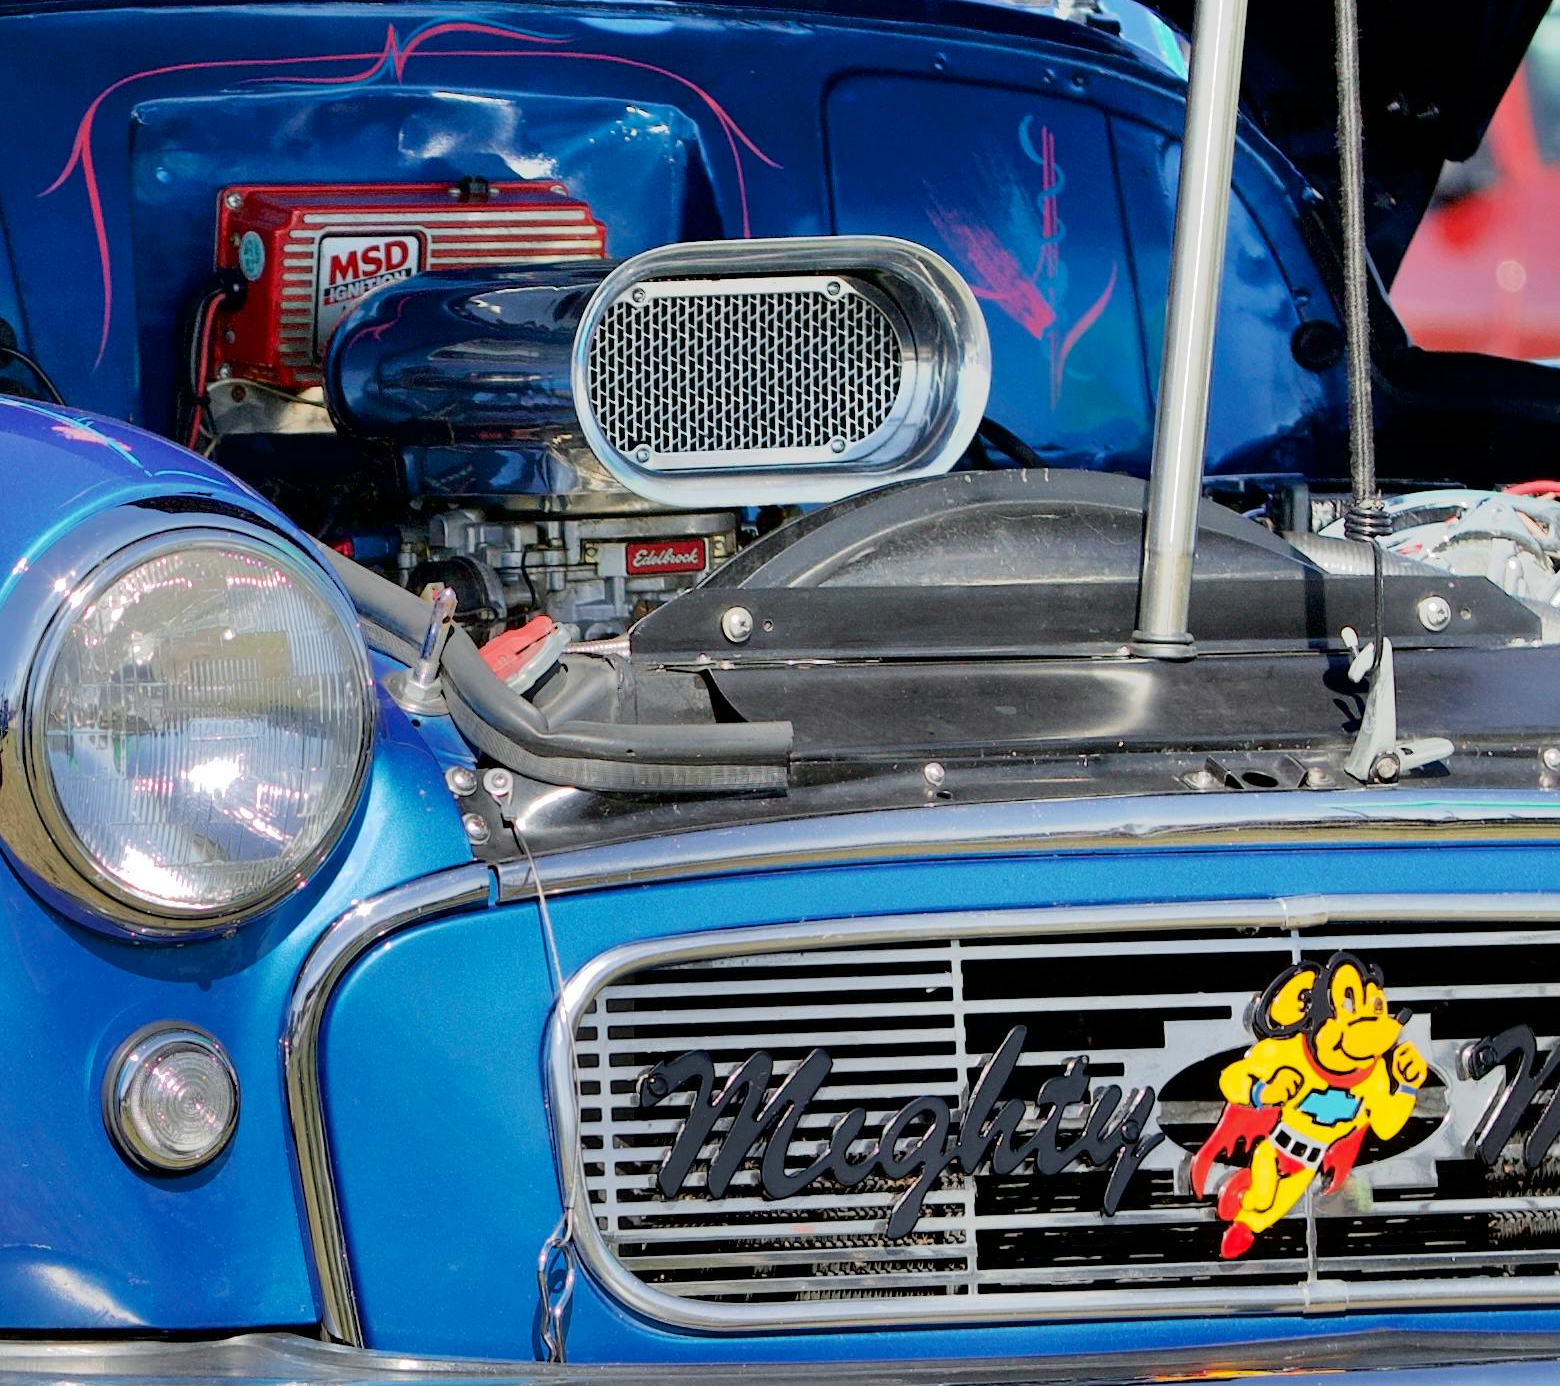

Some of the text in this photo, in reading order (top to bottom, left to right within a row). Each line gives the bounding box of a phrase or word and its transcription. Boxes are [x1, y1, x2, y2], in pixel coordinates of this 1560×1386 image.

[328, 239, 409, 286] MSD
[632, 547, 699, 568] Edelbrock
[636, 1023, 1166, 1240] Mighty
